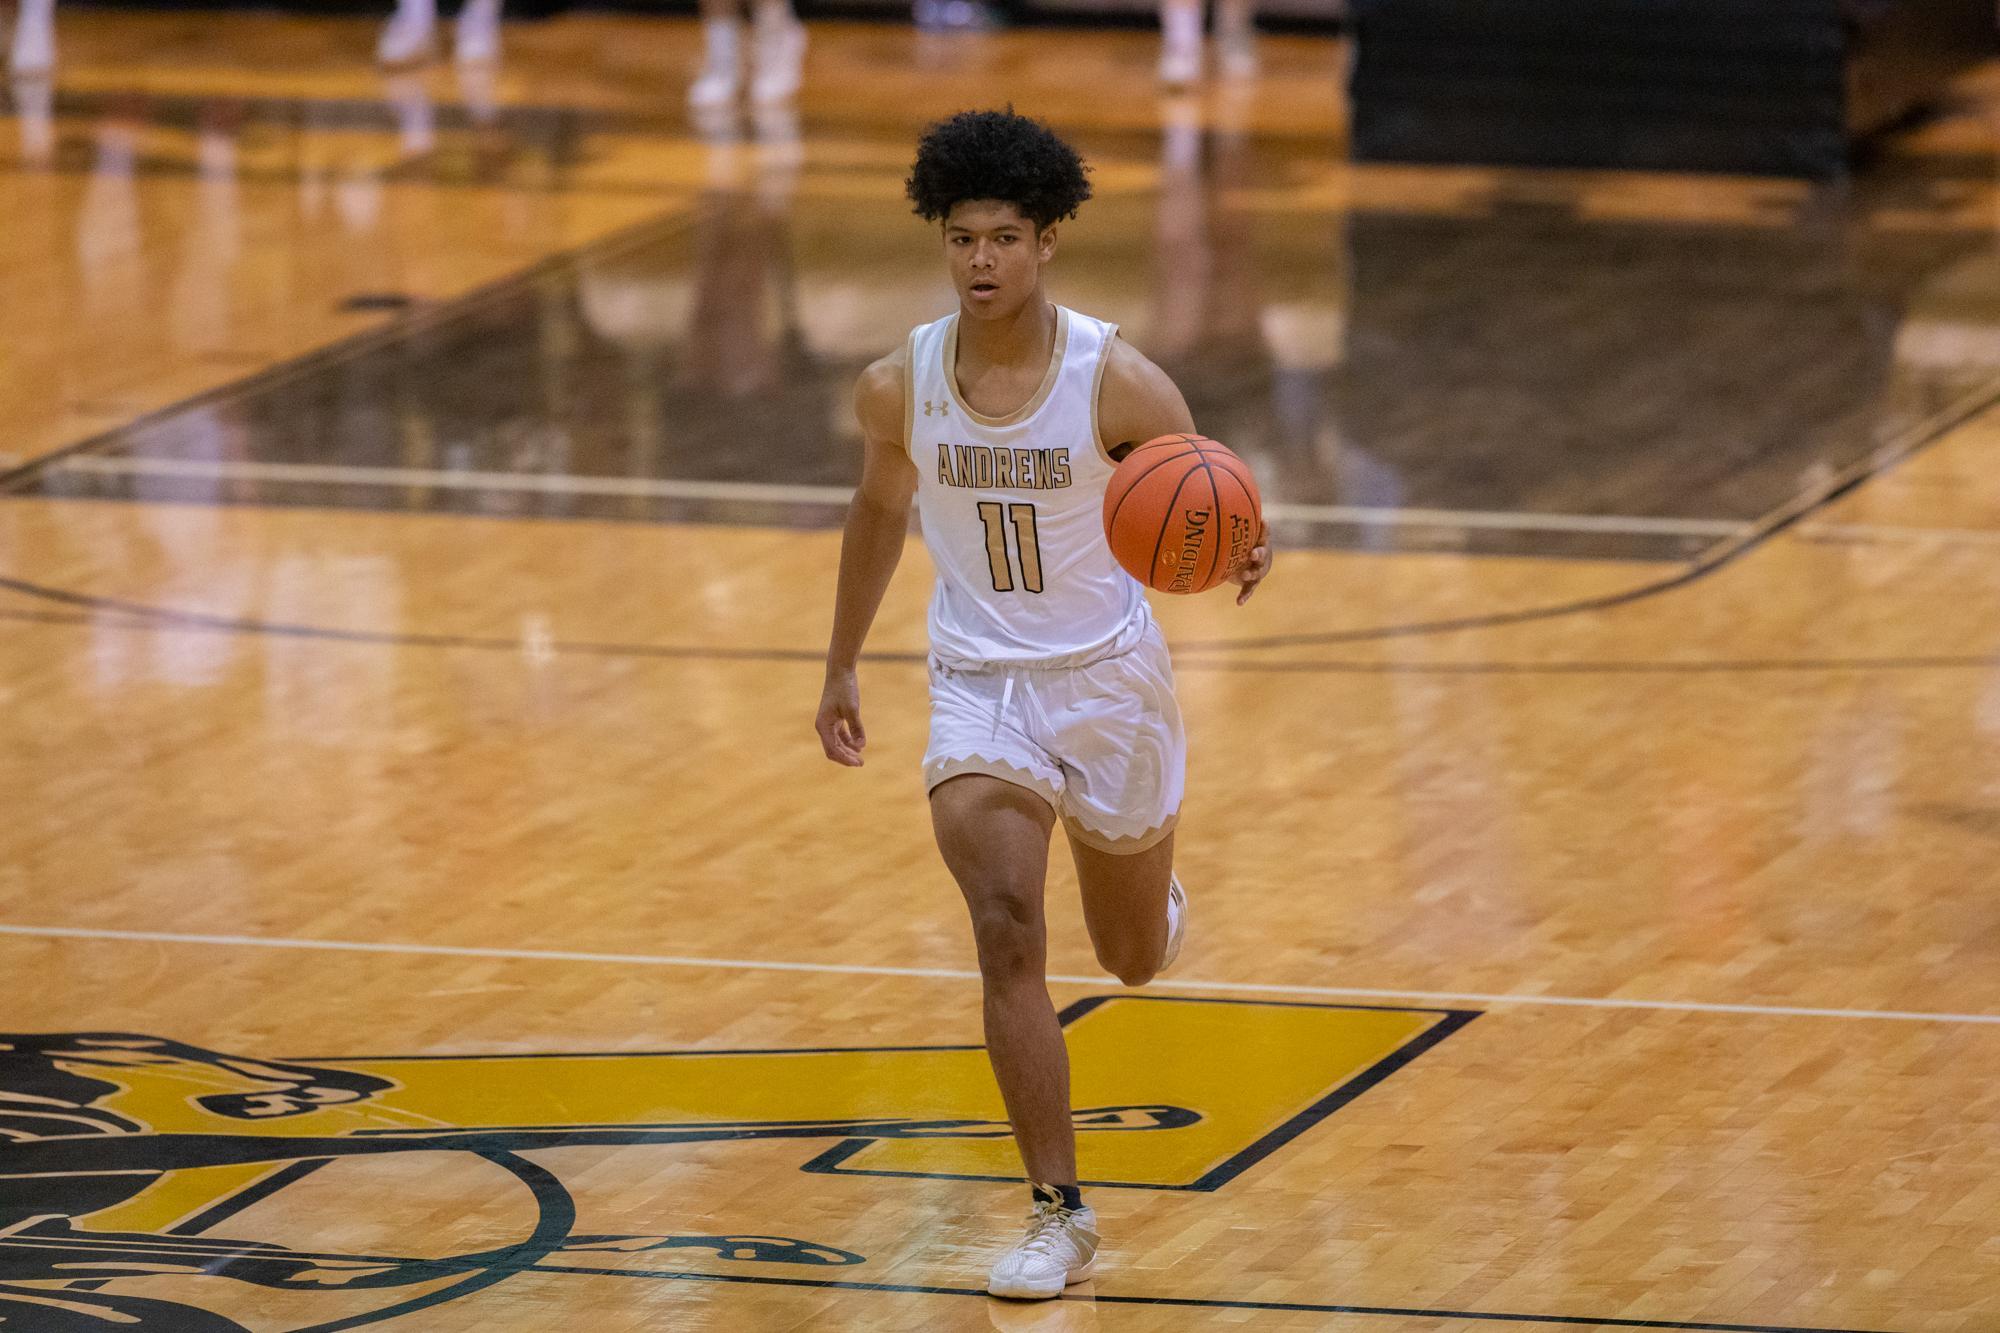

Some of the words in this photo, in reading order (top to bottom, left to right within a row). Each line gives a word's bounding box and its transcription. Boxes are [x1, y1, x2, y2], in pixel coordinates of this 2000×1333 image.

[938, 444, 1072, 489] ANDREWS
[977, 502, 1043, 593] 11
[1168, 510, 1210, 592] PALDING
[1221, 514, 1243, 580] EGACY
